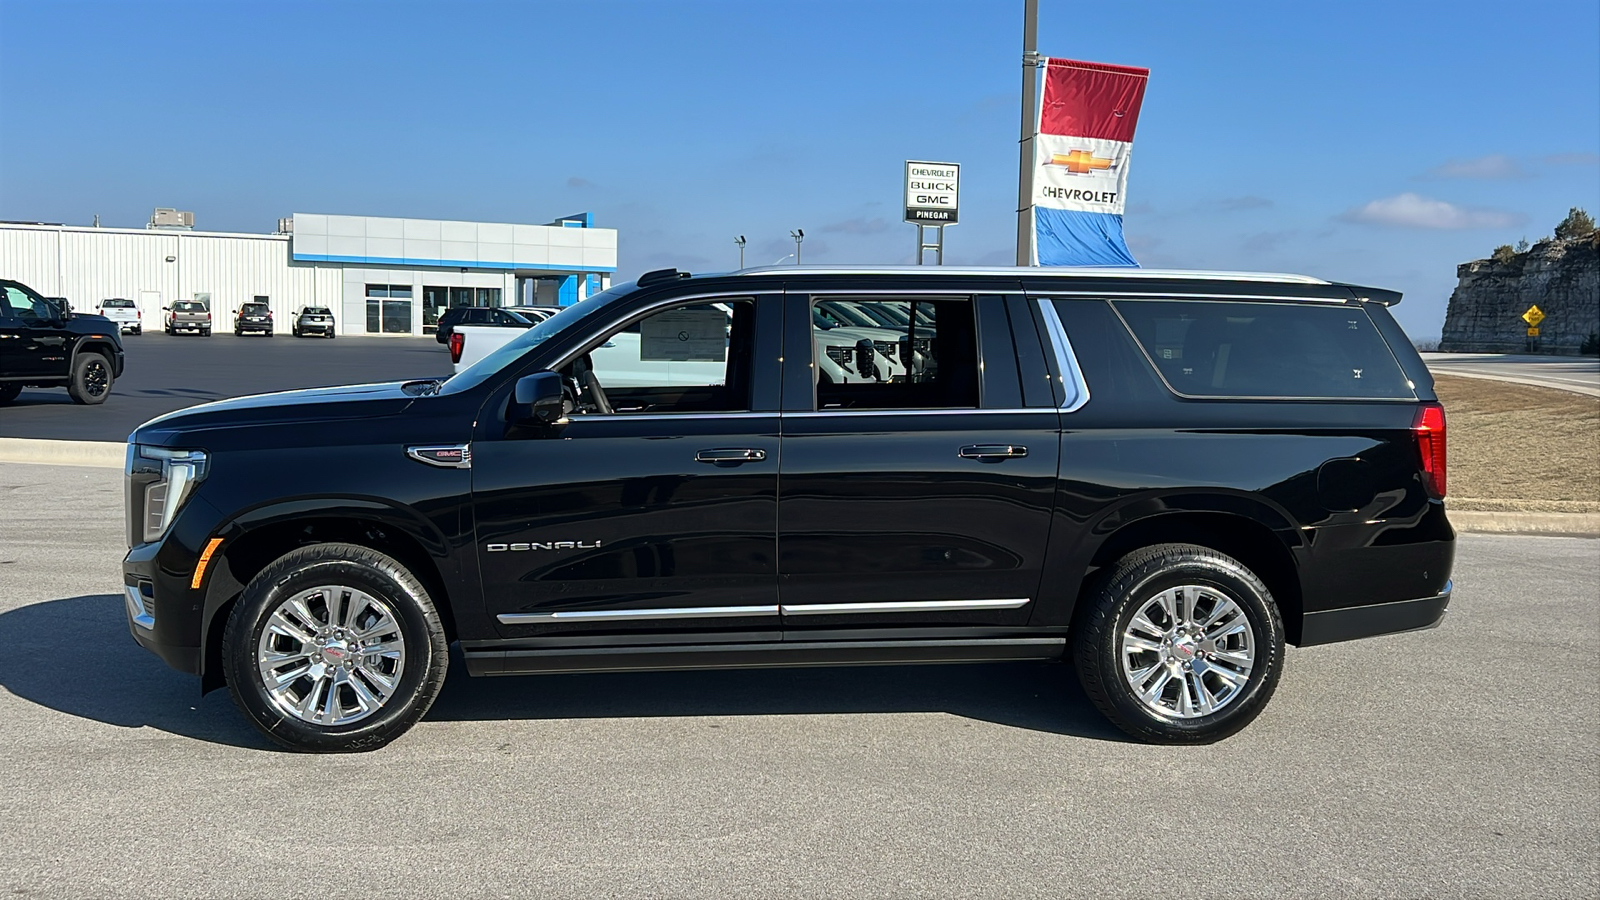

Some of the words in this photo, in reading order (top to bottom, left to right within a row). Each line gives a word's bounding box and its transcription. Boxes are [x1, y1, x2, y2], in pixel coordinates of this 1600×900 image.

[911, 168, 955, 178] CHEVROLET
[910, 181, 955, 192] BUICK
[916, 195, 949, 205] GMC
[916, 210, 949, 220] PINEGAR
[487, 540, 601, 552] DENALI
